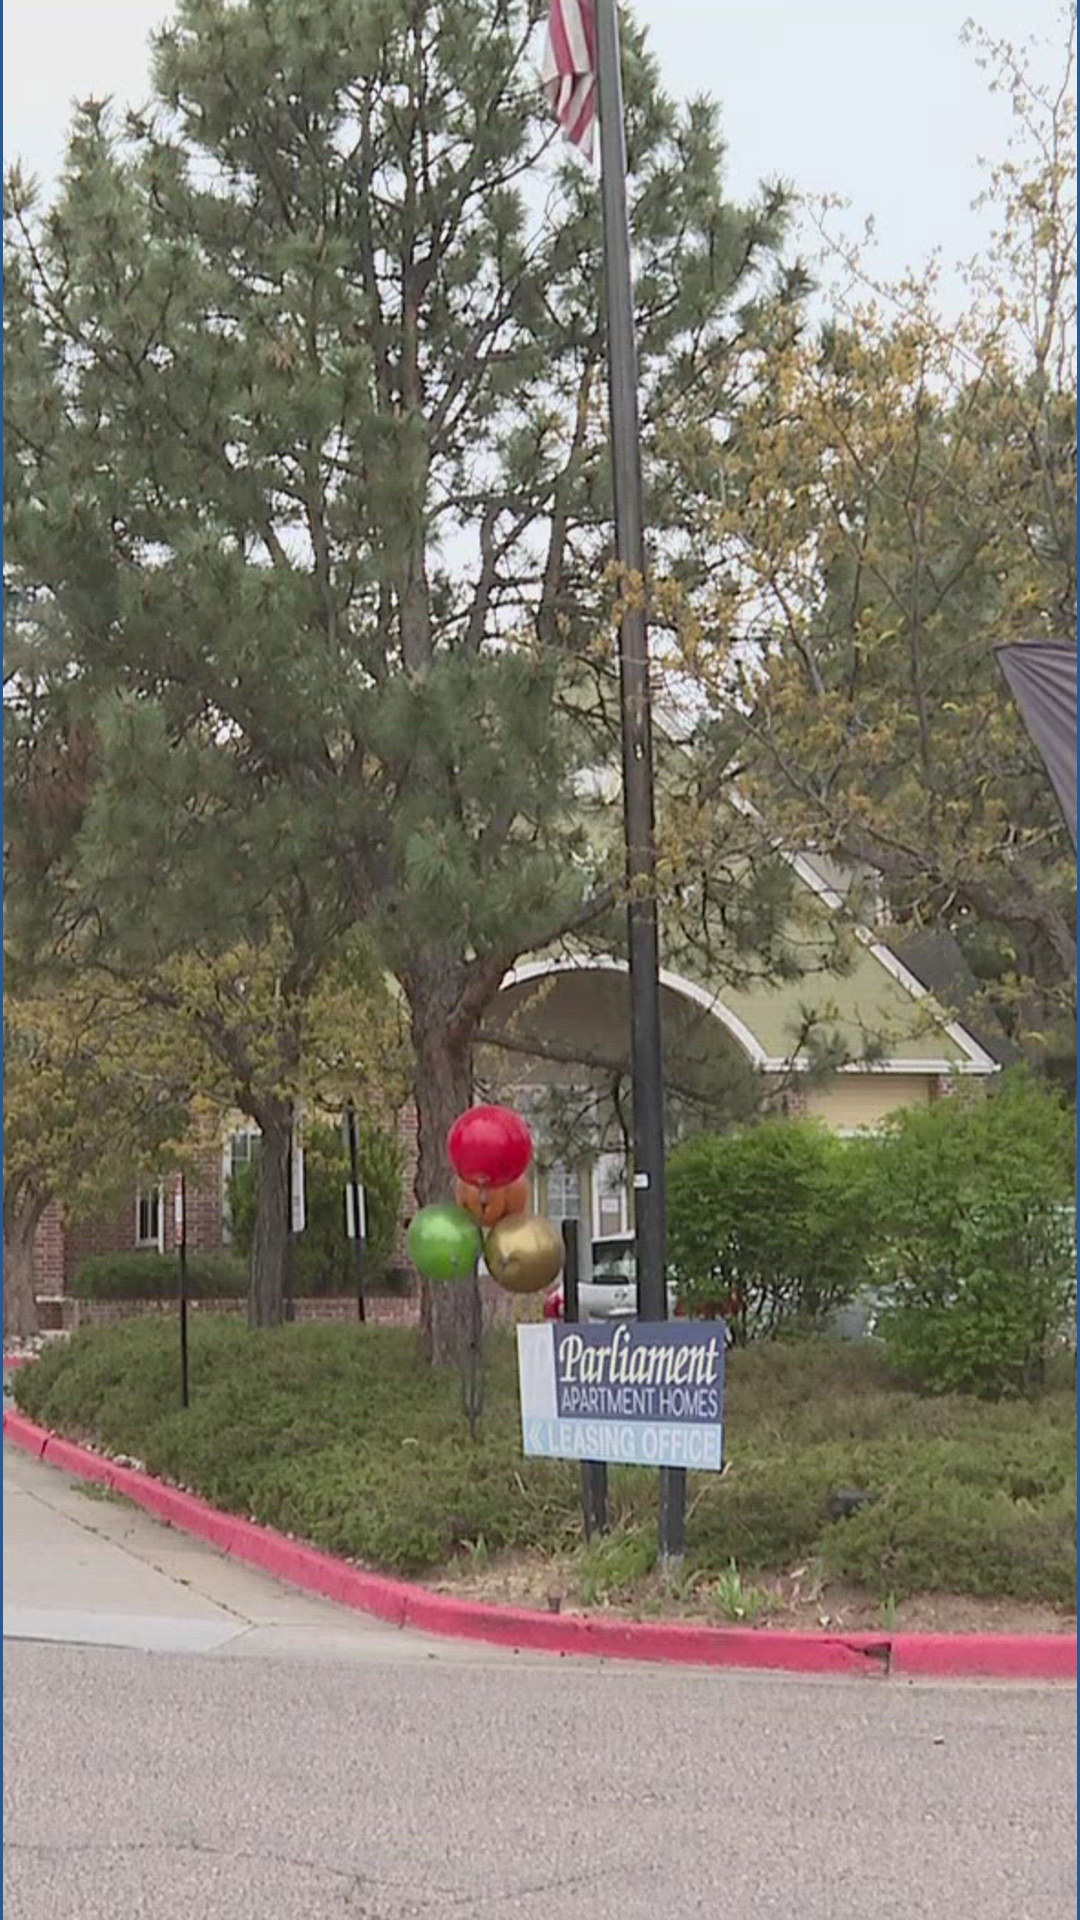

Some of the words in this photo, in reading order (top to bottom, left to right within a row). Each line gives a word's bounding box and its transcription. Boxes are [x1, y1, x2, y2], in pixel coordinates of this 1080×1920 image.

[559, 1324, 719, 1386] Parliament
[561, 1386, 654, 1415] APARTMENT
[660, 1389, 718, 1418] HOMES
[548, 1424, 635, 1458] LEASING
[642, 1427, 716, 1462] OFFICE
